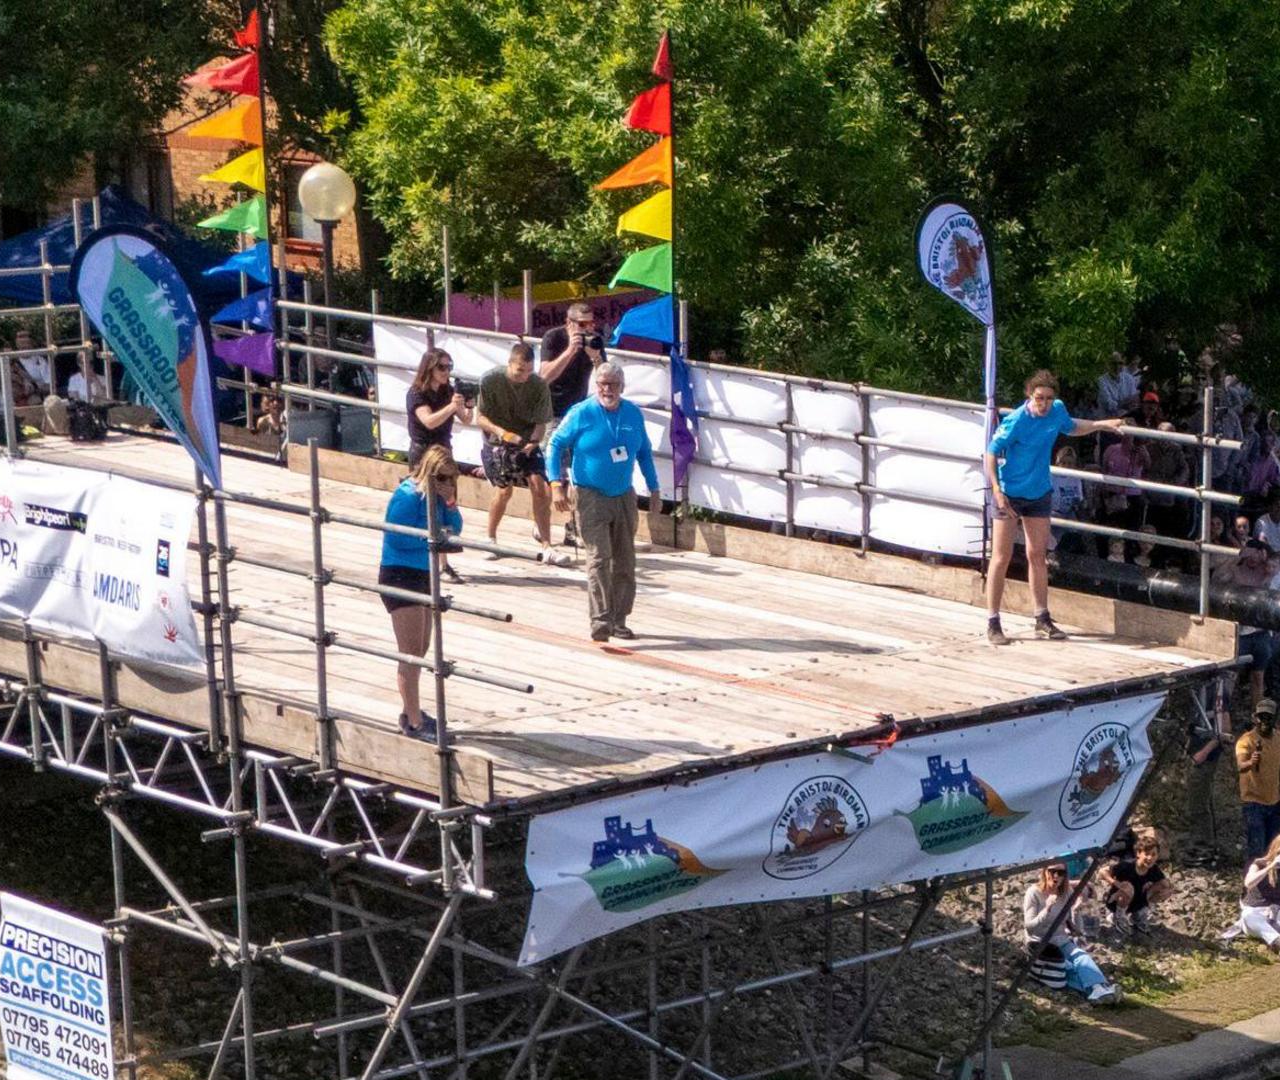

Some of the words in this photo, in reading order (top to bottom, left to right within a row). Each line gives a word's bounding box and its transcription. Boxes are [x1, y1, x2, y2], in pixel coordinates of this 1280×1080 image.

[108, 286, 180, 394] GRASSROOT
[93, 572, 141, 611] AMDARIS
[1075, 750, 1089, 772] THE
[1085, 728, 1119, 751] BRISTOL
[778, 806, 795, 828] THE
[794, 781, 832, 806] BRISTOL
[833, 783, 865, 829] BIRDMAN
[920, 810, 993, 836] GRASSROOT
[920, 821, 1002, 851] COMMUNITIES
[602, 867, 683, 898] GRASSROOT
[603, 876, 701, 910] COMMUNITIES
[2, 925, 102, 977] PRECISION
[0, 951, 104, 1007] ACCESS
[0, 977, 106, 1025] SCAFFOLDING
[3, 1007, 49, 1036] 07795
[54, 1024, 108, 1059] 472091
[6, 1028, 51, 1058] 07795
[56, 1046, 110, 1080] 474489
